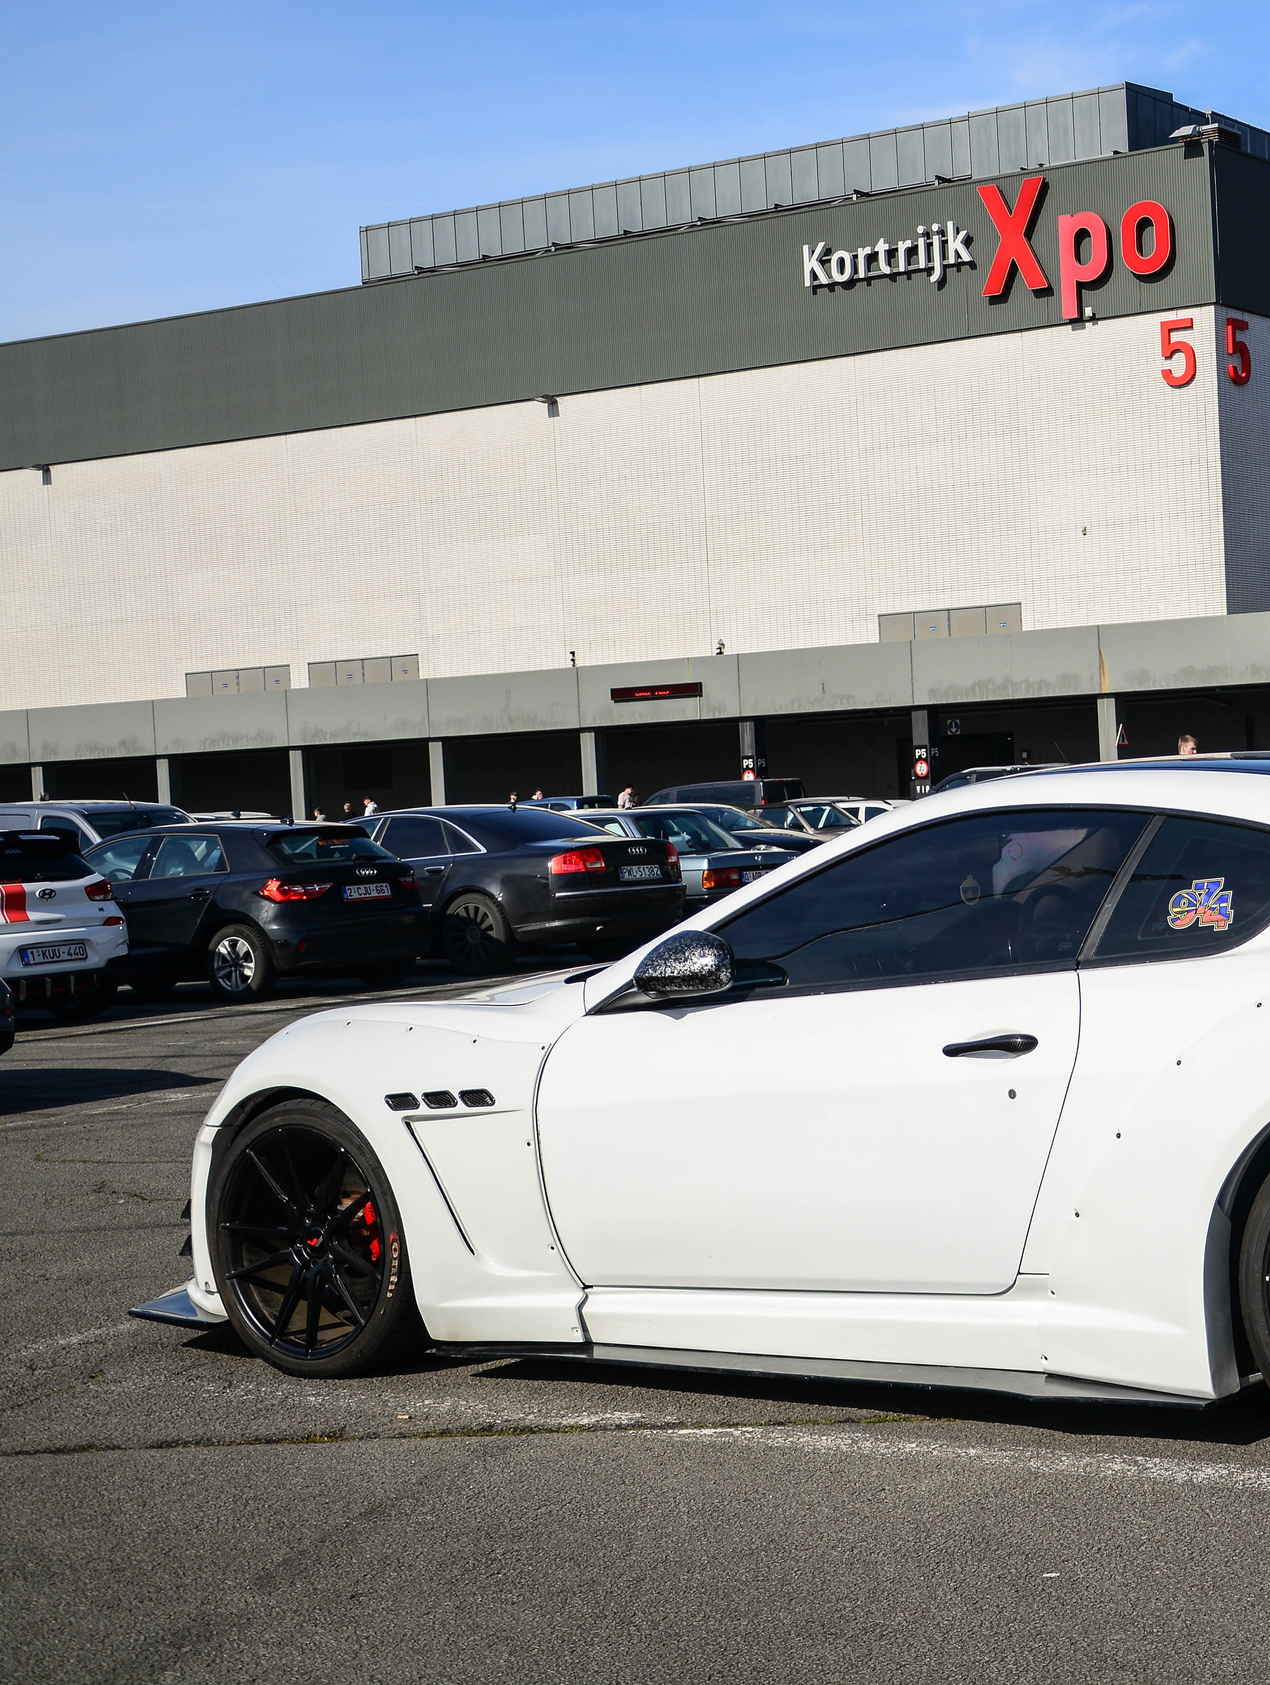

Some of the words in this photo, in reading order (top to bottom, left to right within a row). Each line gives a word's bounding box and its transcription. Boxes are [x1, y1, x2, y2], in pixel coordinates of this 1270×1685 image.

[802, 220, 974, 287] Kortrijk
[977, 176, 1172, 319] Xpo
[1160, 317, 1197, 387] 5
[1226, 317, 1252, 386] 5
[915, 748, 927, 759] P5
[930, 747, 939, 757] P5
[742, 758, 754, 769] P5
[757, 758, 766, 767] P5
[916, 785, 930, 794] VIP
[30, 945, 85, 962] 1-KUU-440
